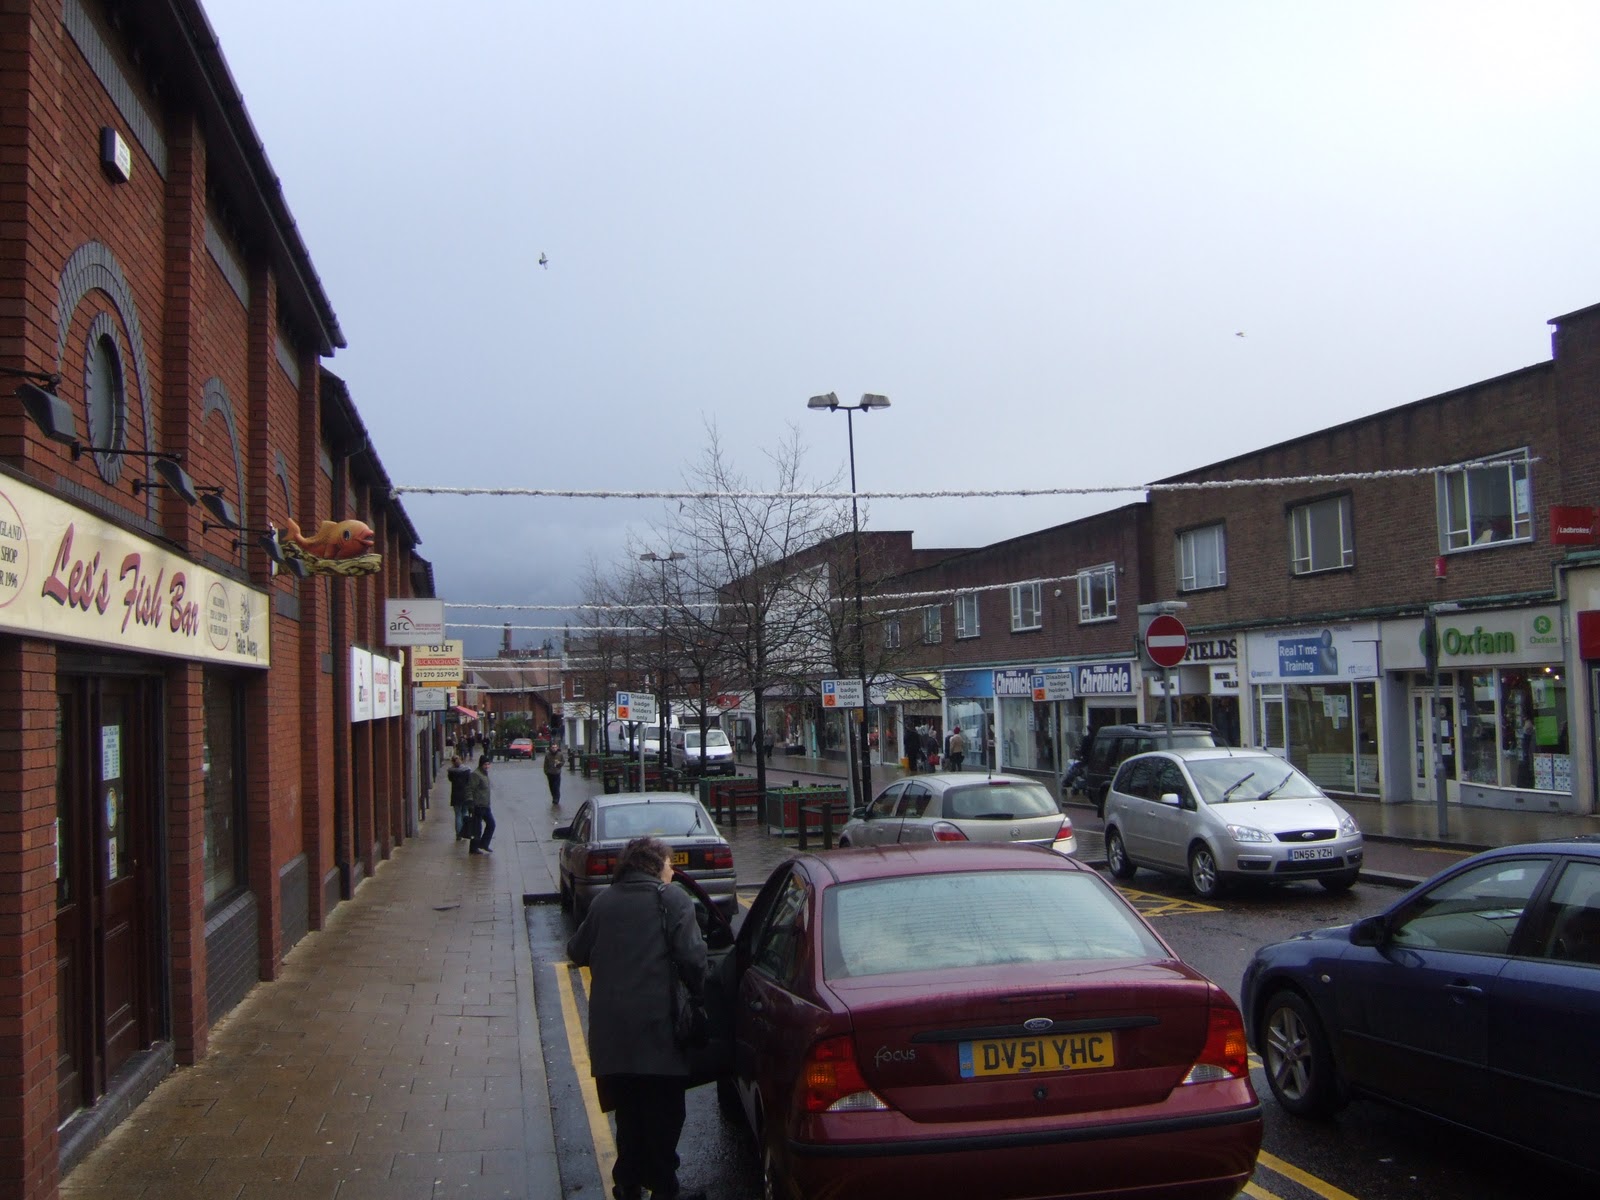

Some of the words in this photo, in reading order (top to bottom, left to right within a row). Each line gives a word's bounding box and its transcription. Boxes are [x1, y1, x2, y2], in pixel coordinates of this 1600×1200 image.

[1, 545, 18, 564] SHOP
[41, 522, 111, 615] Les's
[119, 552, 163, 634] Fish
[169, 571, 199, 637] Bar
[389, 621, 410, 631] arc
[1442, 625, 1516, 656] Oxfam
[1529, 635, 1558, 644] Oxfam
[428, 645, 440, 653] TO
[441, 644, 454, 653] LET
[1279, 644, 1297, 657] Real
[1297, 644, 1318, 656] Tme
[1284, 660, 1314, 673] Training
[1080, 667, 1128, 693] Chronicle
[630, 693, 654, 701] Disabled
[1317, 849, 1332, 858] YZH
[982, 1040, 1045, 1071] DV51
[1052, 1036, 1105, 1065] YHC
